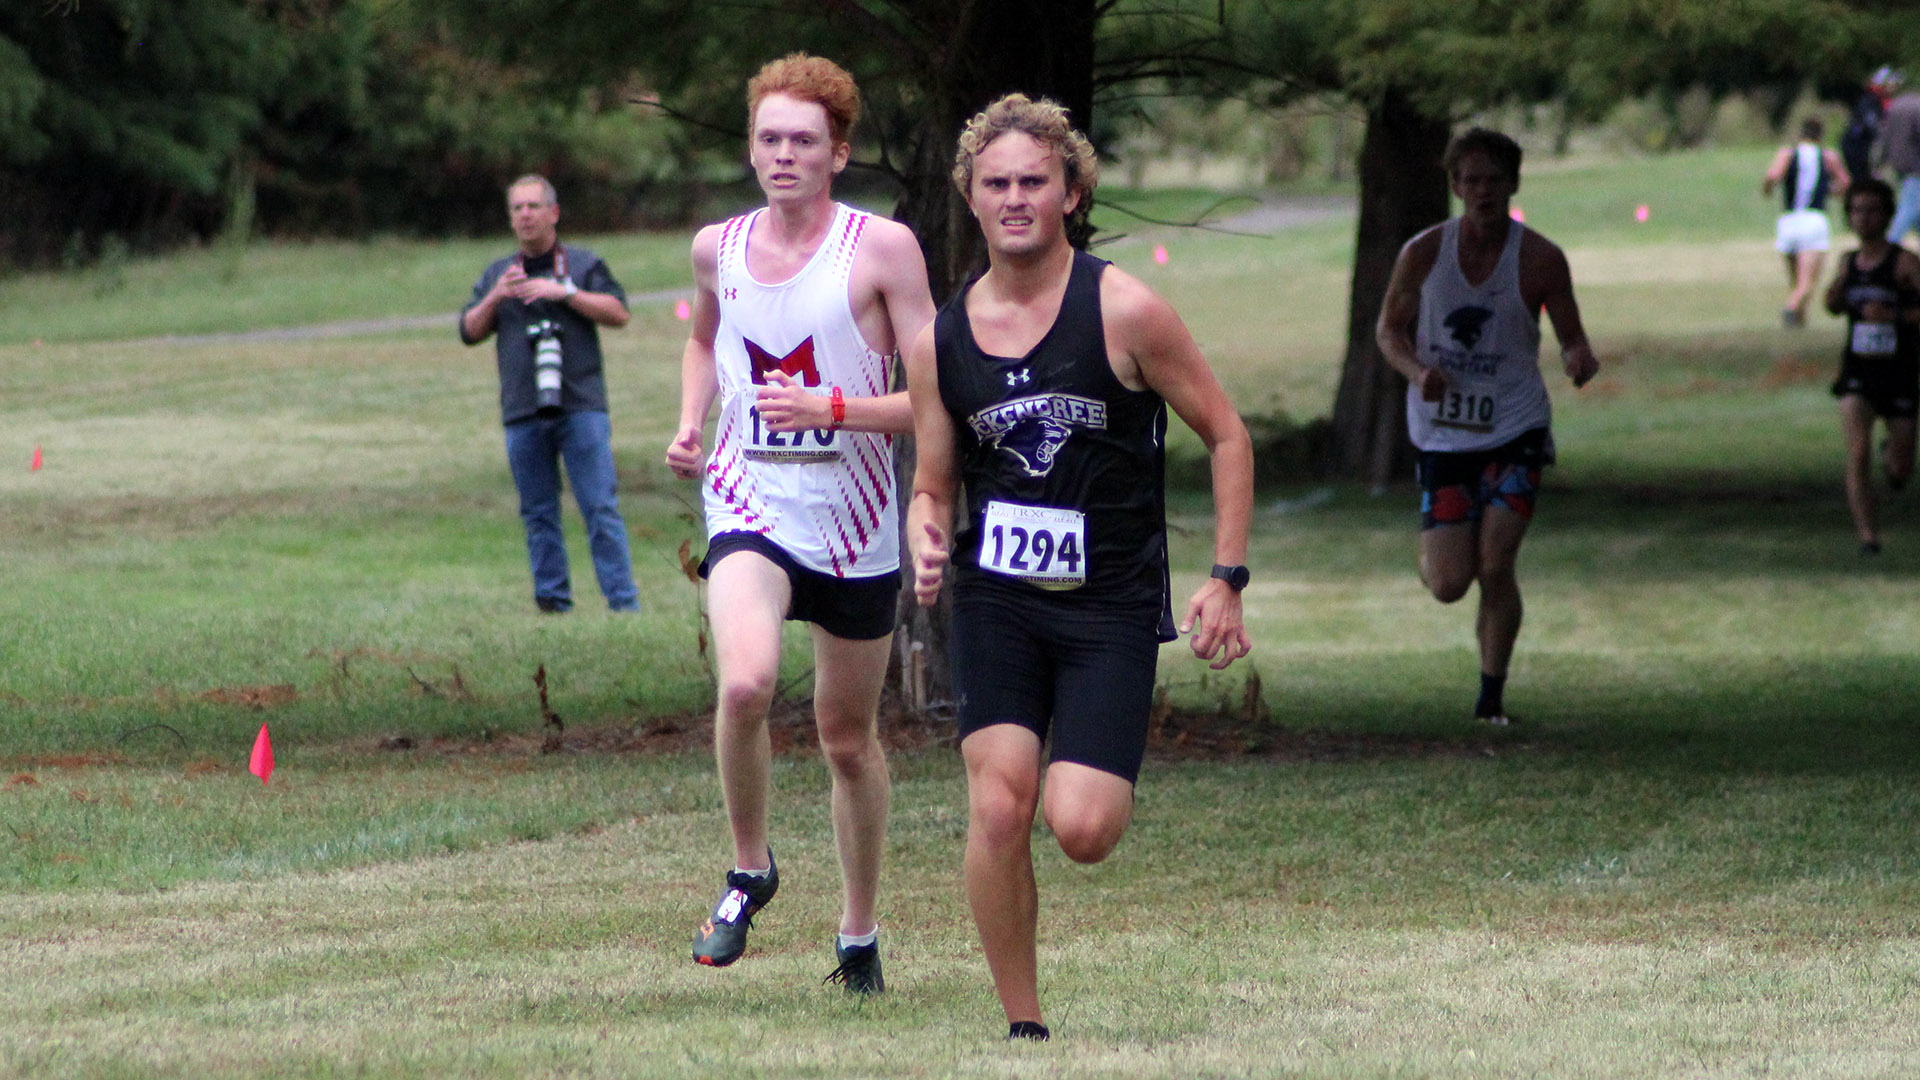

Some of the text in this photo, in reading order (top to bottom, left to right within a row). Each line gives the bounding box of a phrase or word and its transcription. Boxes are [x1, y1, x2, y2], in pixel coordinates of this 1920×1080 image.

[742, 334, 822, 388] M
[1437, 391, 1494, 421] 1310
[745, 449, 837, 457] WWW.TRXCTIMING.COM
[992, 524, 1081, 573] 1294
